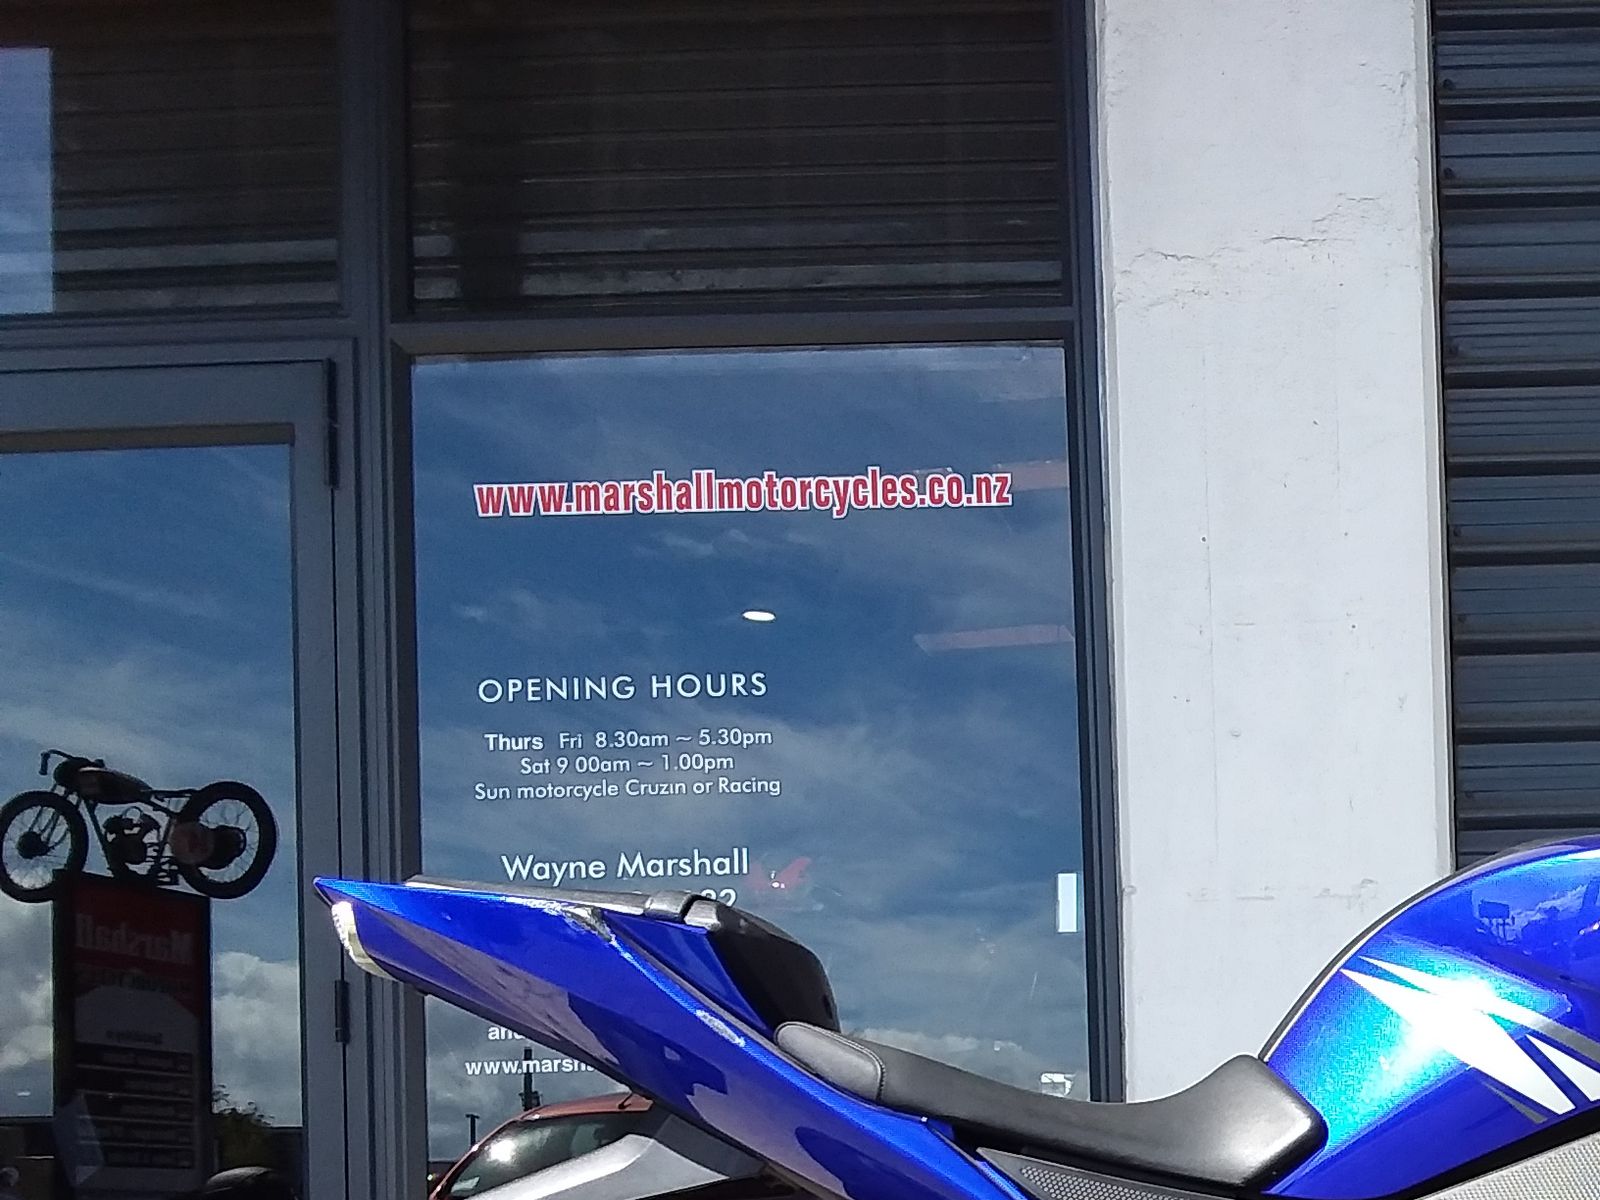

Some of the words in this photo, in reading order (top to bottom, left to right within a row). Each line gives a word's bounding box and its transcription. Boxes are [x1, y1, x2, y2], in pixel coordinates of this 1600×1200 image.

[474, 467, 1013, 519] www.marshallmotorcycles.co.nz
[477, 675, 636, 703] OPENING
[651, 671, 768, 699] HOURS
[484, 733, 544, 752] Thurs
[559, 732, 583, 750] Fri
[595, 730, 669, 749] 8.30am
[698, 728, 773, 749] 5.30pm
[520, 757, 550, 775] Sat
[662, 753, 734, 775] 1.00pm
[474, 782, 510, 801] Sun
[517, 779, 619, 802] motorcycle
[625, 779, 686, 797] Cruzin
[692, 781, 713, 795] or
[718, 776, 782, 797] Racing
[501, 854, 606, 885] Wayne
[617, 847, 749, 877] Marshall
